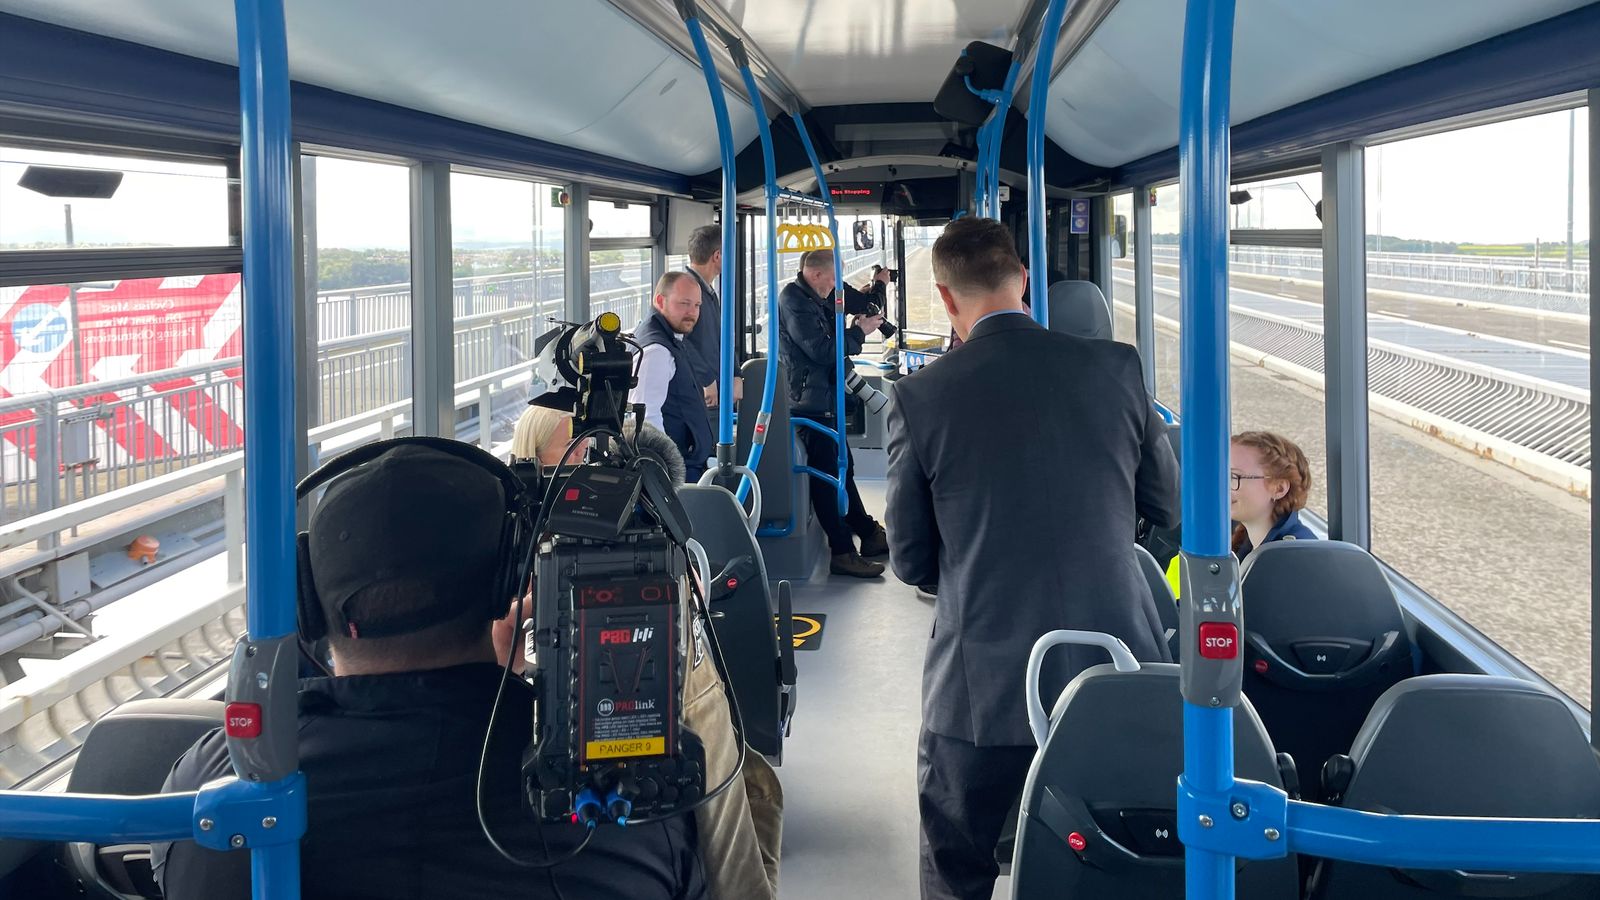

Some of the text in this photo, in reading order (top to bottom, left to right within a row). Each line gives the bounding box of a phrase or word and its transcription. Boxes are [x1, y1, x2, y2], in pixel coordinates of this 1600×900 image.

[1205, 637, 1233, 647] STOP
[230, 717, 253, 728] STOP
[599, 742, 652, 754] RANGER 9
